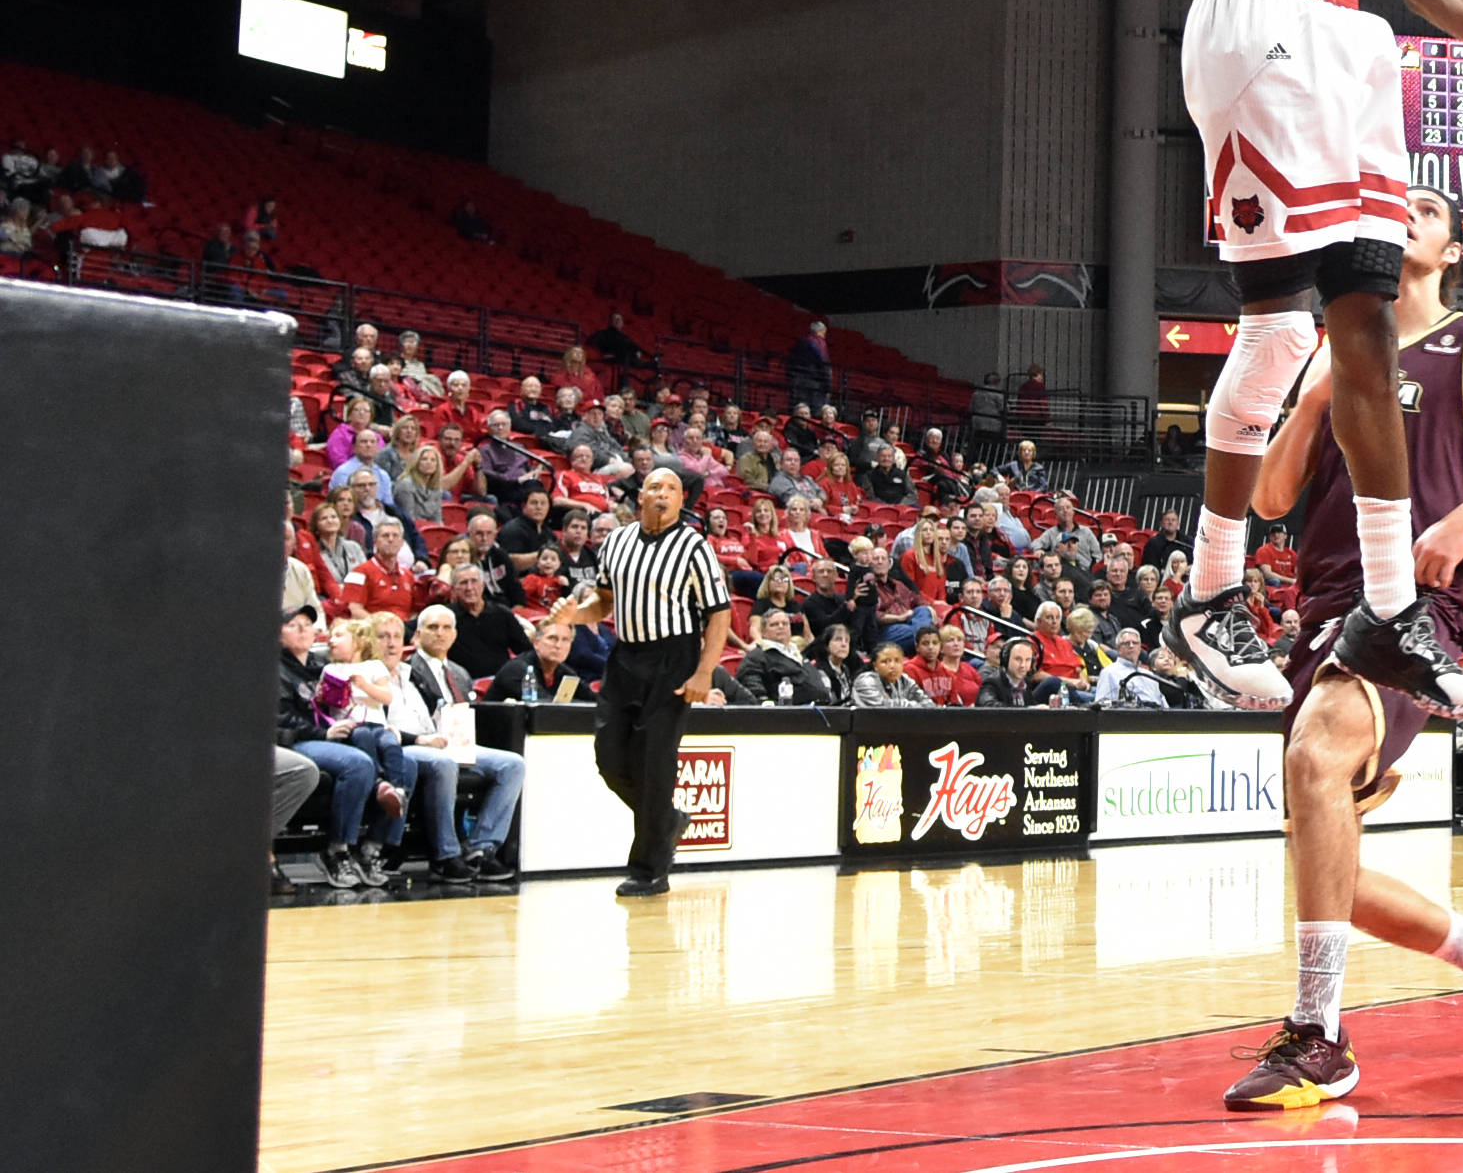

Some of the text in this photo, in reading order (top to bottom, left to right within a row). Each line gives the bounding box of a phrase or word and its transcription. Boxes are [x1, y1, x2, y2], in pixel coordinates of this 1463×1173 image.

[1429, 61, 1436, 73] 1
[1427, 78, 1437, 91] 4
[1427, 95, 1437, 108] 5
[1426, 112, 1440, 126] 11
[1425, 129, 1441, 143] 23
[1236, 429, 1265, 438] adidas
[1023, 742, 1068, 768] Serving
[1023, 767, 1079, 788] Northeast
[1103, 748, 1278, 817] suddenlink
[673, 786, 726, 813] REAU
[914, 742, 1017, 840] Hays
[1023, 790, 1077, 812] Arkansas
[853, 779, 904, 831] Hays
[1022, 813, 1079, 835] Since 1935
